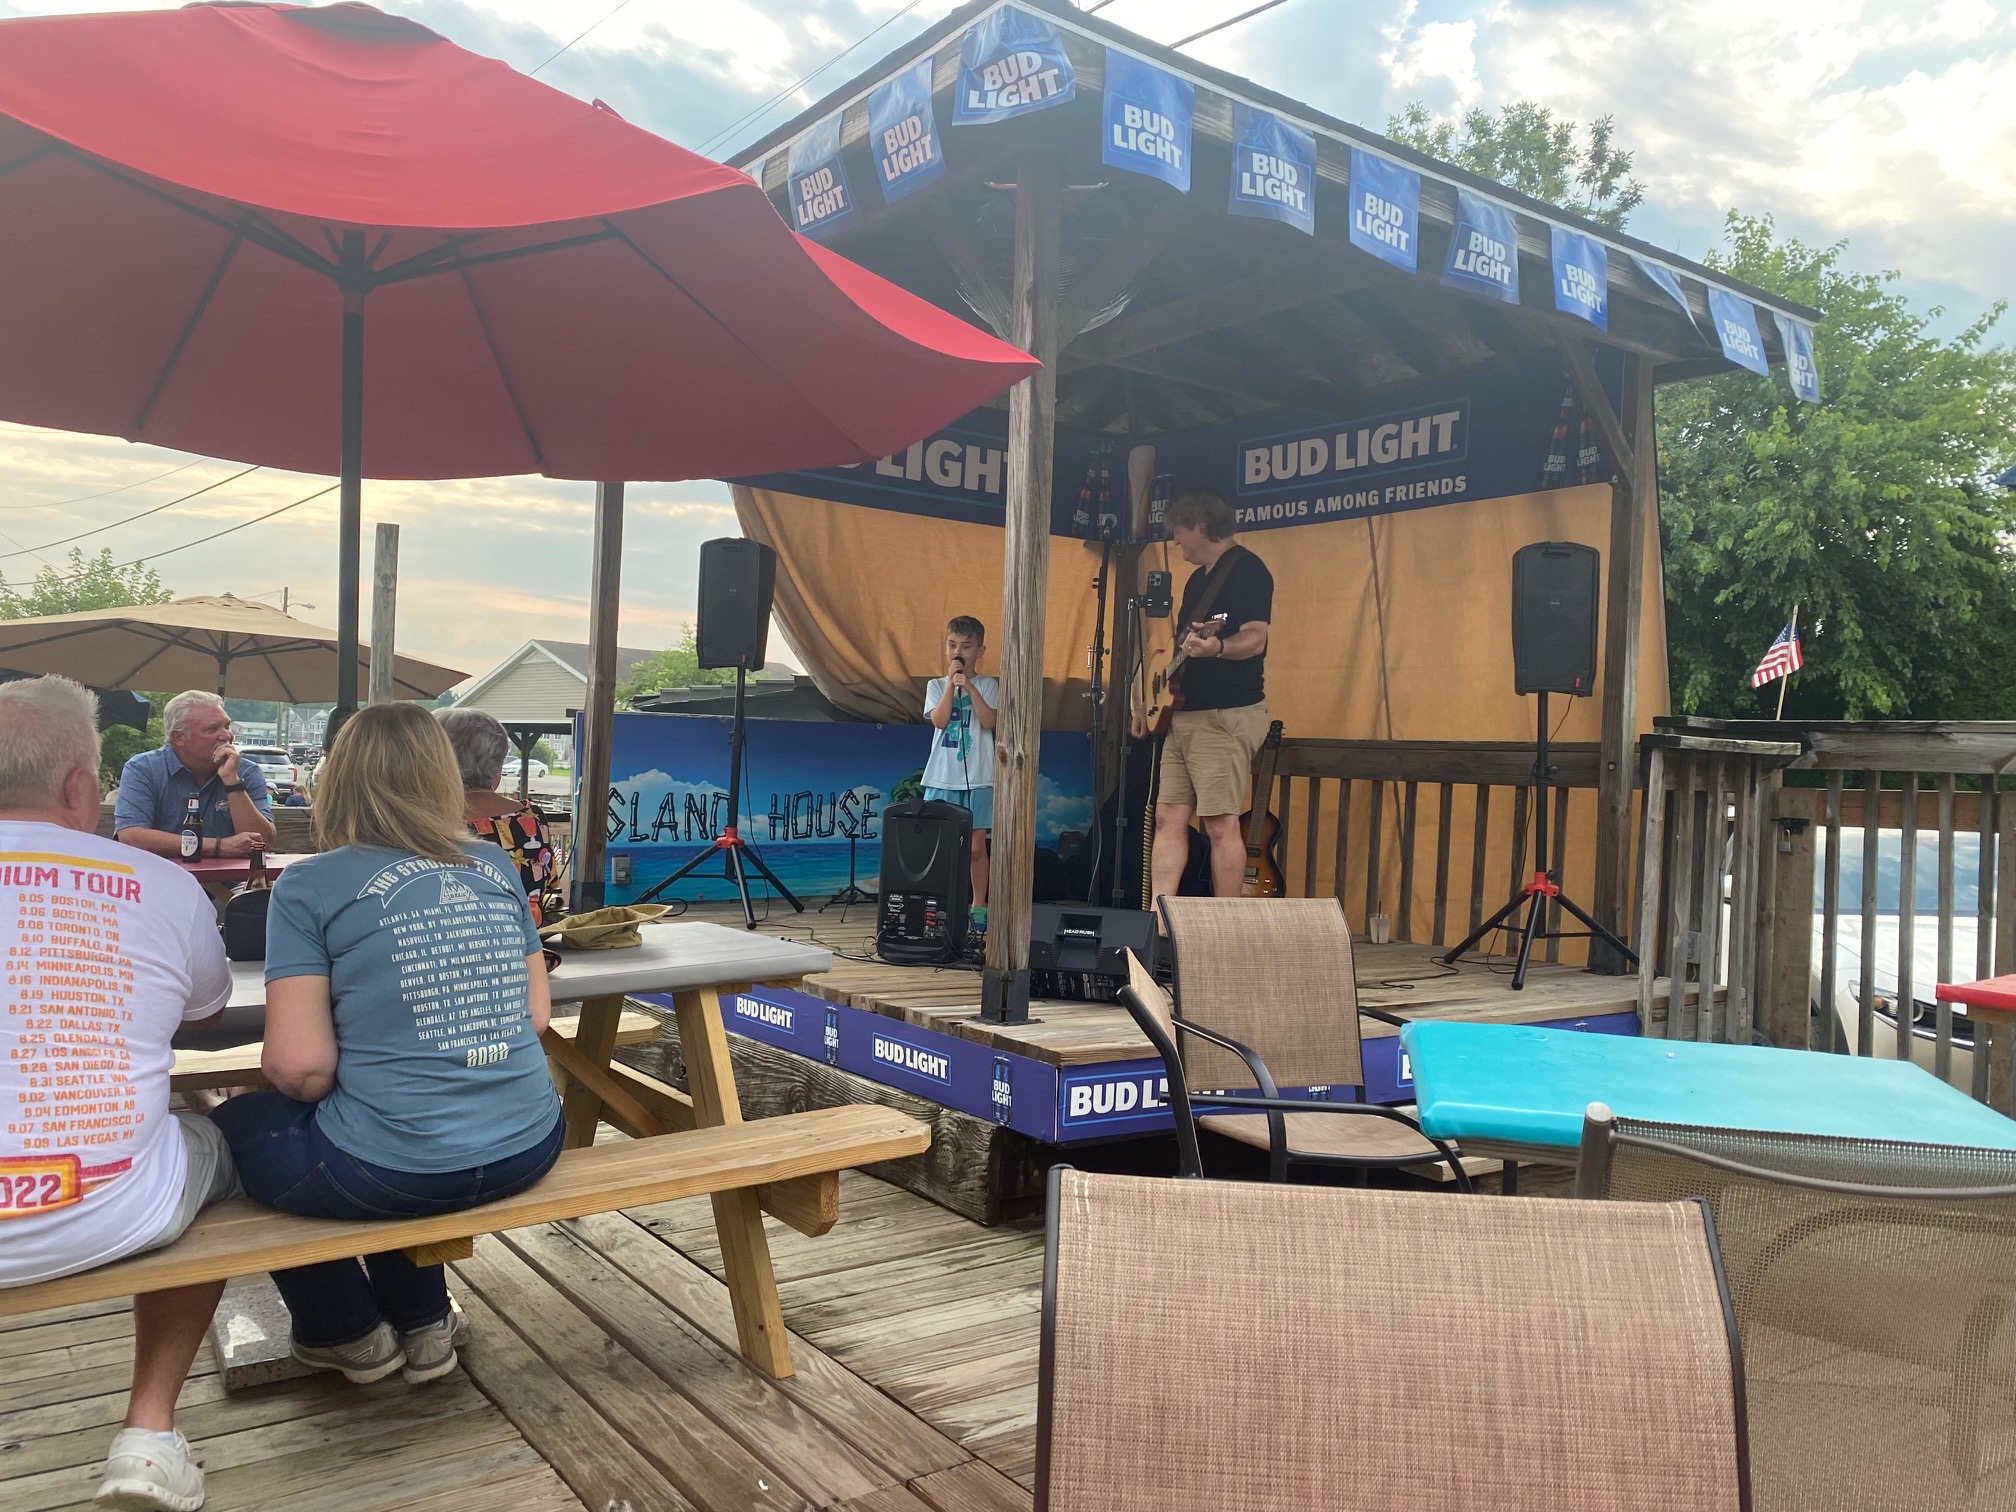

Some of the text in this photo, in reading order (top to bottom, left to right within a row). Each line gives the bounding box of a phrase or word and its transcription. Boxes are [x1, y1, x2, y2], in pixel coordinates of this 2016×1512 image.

[983, 52, 1043, 92] BUD
[968, 68, 1062, 110] LIGHT
[1124, 103, 1175, 142] BUD
[884, 115, 923, 155] BUD
[1113, 123, 1183, 171] LIGHT
[882, 134, 934, 183] LIGHT
[1251, 152, 1298, 186] BUD
[800, 167, 834, 201] BUD
[1241, 172, 1307, 212] LIGHT
[797, 183, 847, 227] LIGHT
[1364, 191, 1404, 227] BUD
[1356, 210, 1409, 253] LIGHT
[1468, 231, 1506, 263] BUD
[1454, 247, 1512, 286] LIGHT
[1566, 263, 1596, 291] BUD
[1561, 279, 1602, 314] LIGHT
[1724, 319, 1751, 342] BUD
[1723, 333, 1759, 360] LIGHT
[1245, 411, 1460, 485] BUD LIGHT
[1548, 454, 1566, 463] BUD
[1579, 446, 1597, 457] BUD
[876, 440, 1008, 494] LIGH
[1544, 462, 1566, 472] LIGHT
[1577, 453, 1600, 467] LIGHT
[1151, 499, 1168, 512] BU
[1235, 475, 1467, 524] FAMOUS AMONG FRIENDS
[1073, 515, 1089, 526] LIGHT
[1076, 509, 1089, 519] BUD
[1149, 512, 1162, 523] LIG
[607, 787, 880, 842] SLAND HOUSE
[0, 866, 141, 904] IUM TOUR
[367, 872, 399, 896] THE
[19, 893, 44, 903] 8.05
[101, 902, 117, 914] MA
[20, 906, 45, 917] 8.06
[103, 917, 118, 928] MA
[17, 920, 44, 929] 8.08
[106, 930, 119, 942] ON
[21, 933, 44, 943] 8.10
[106, 943, 119, 954] NY
[9, 947, 31, 956] 8.12
[118, 957, 131, 967] PA
[6, 961, 29, 970] 8.14
[119, 969, 134, 981] MN
[9, 975, 32, 985] 8.16
[123, 984, 133, 994] IN
[21, 989, 43, 999] 8.19
[112, 995, 124, 1006] TX
[9, 1005, 32, 1015] 8.21
[40, 1005, 64, 1015] SAN
[121, 1010, 133, 1021] TX
[736, 997, 792, 1028] BUD LIGHT
[26, 1019, 52, 1029] 8.22
[107, 1022, 120, 1033] TX
[825, 1026, 837, 1037] BUD
[19, 1034, 46, 1044] 8.25
[114, 1037, 126, 1047] AZ
[824, 1035, 839, 1048] LIGHT
[11, 1049, 37, 1059] 8.27
[45, 1047, 67, 1058] LOS
[120, 1050, 130, 1061] CA
[467, 1042, 509, 1067] 2022
[874, 1038, 948, 1079] BUD LIGHT
[20, 1062, 48, 1073] 8.28
[55, 1060, 79, 1071] SAN
[118, 1061, 130, 1071] CA
[30, 1077, 52, 1088] 8.31
[110, 1073, 128, 1083] WA
[993, 1080, 1010, 1095] BUD
[19, 1092, 45, 1103] 9.02
[125, 1086, 136, 1096] BC
[992, 1090, 1012, 1107] LIGHT
[1070, 1081, 1138, 1117] BUD
[24, 1107, 51, 1118] 9.04
[124, 1100, 135, 1110] AB
[8, 1123, 34, 1134] 9.07
[42, 1121, 66, 1132] SAN
[135, 1113, 145, 1124] CA
[24, 1138, 49, 1149] 9.09
[57, 1136, 79, 1148] LAS
[122, 1129, 135, 1140] NV
